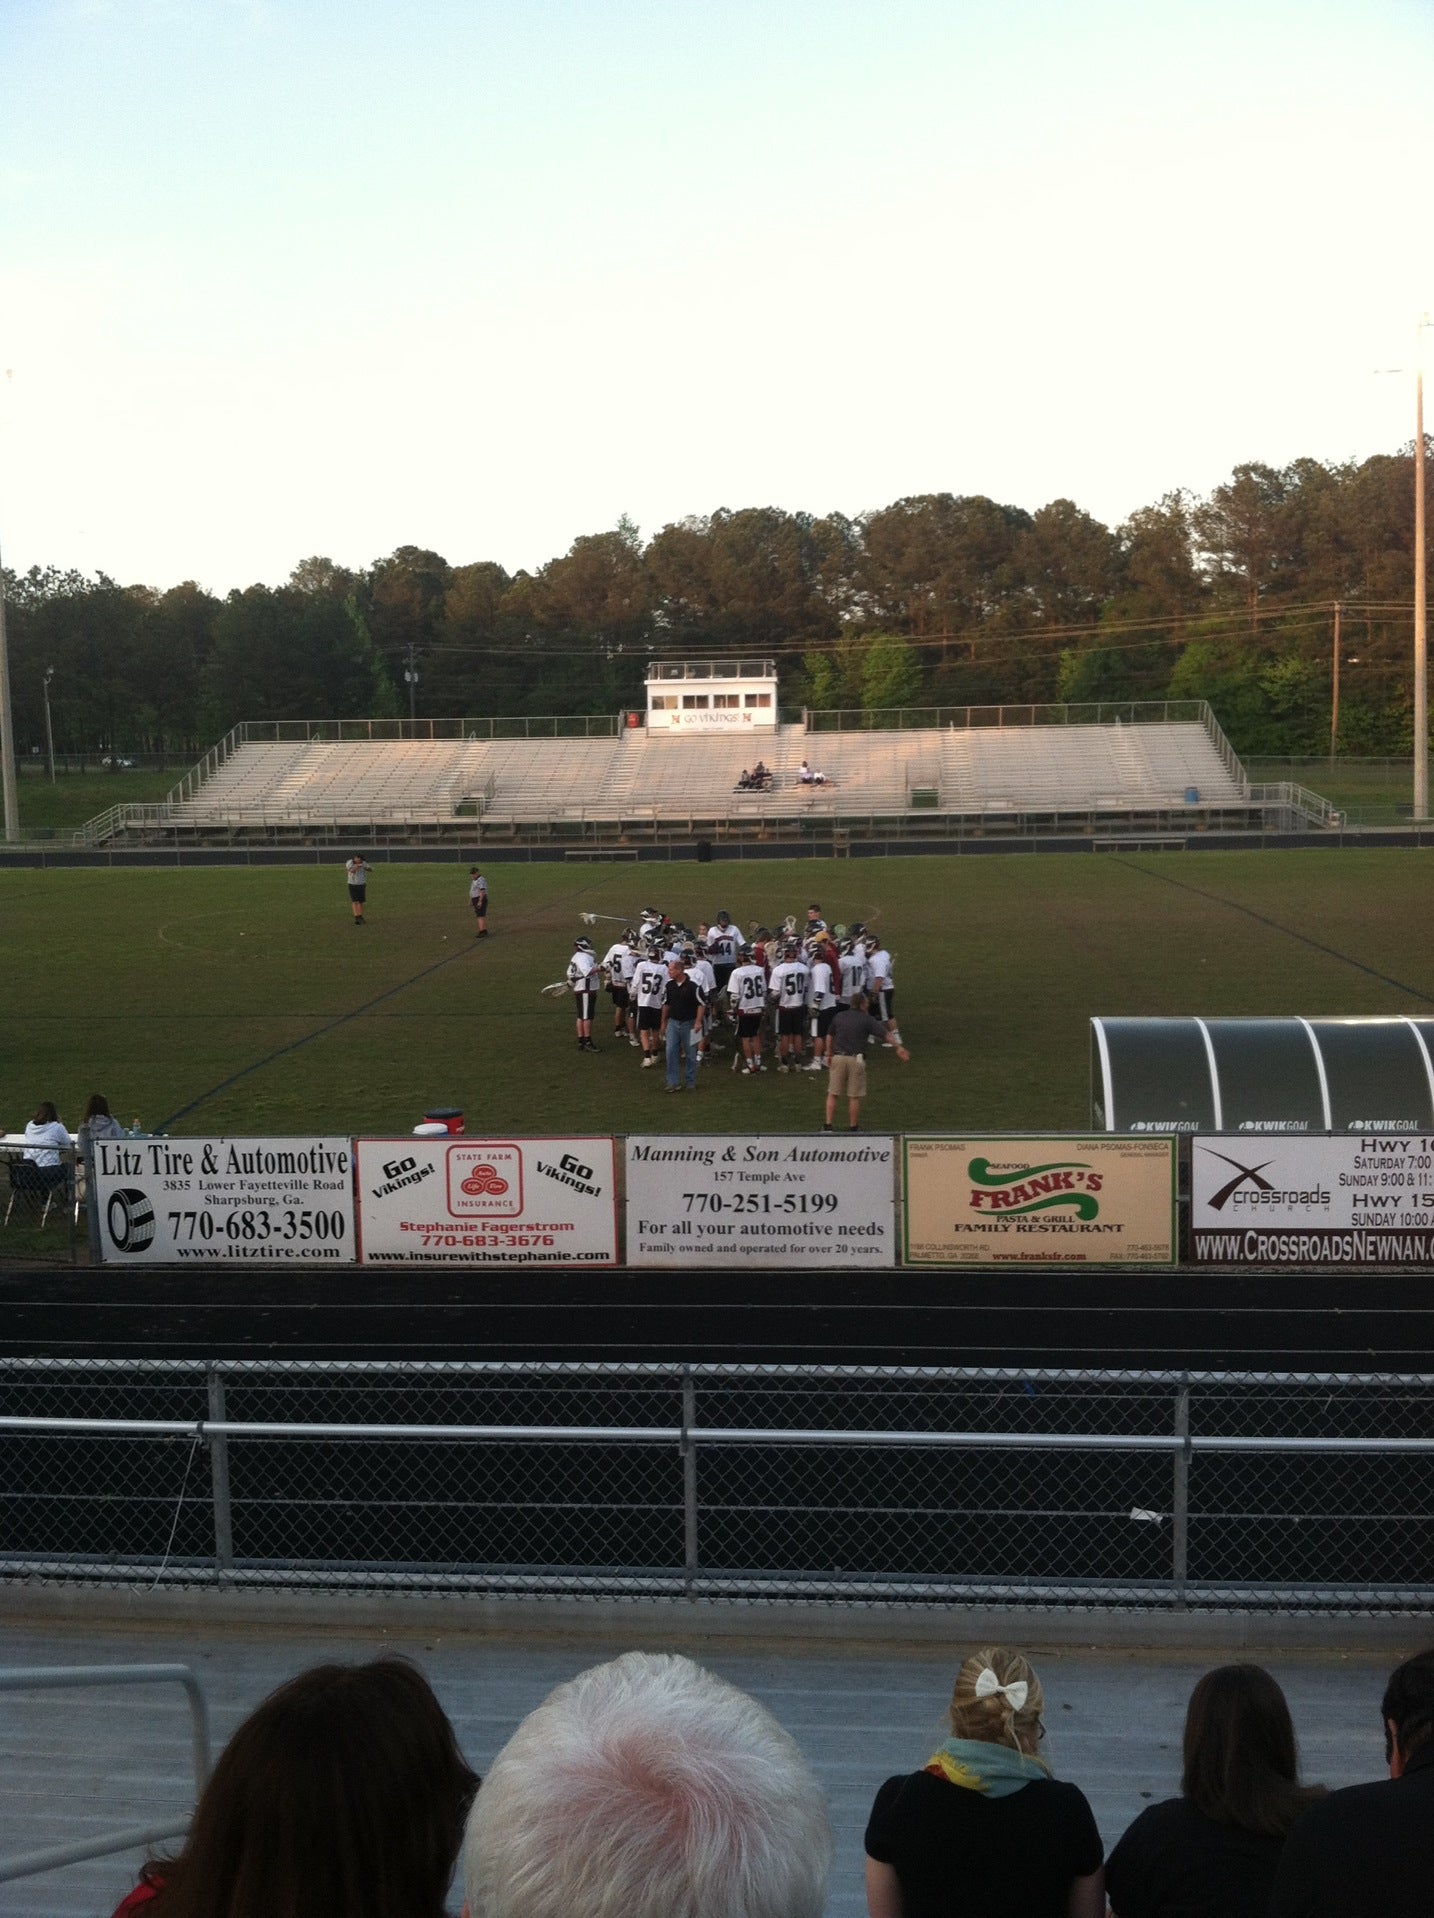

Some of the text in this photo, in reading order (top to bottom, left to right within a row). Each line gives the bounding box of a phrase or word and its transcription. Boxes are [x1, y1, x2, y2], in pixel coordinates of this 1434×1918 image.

[641, 972, 663, 995] 53
[743, 975, 763, 1000] 36
[785, 972, 804, 996] 50
[100, 1142, 348, 1176] Litz Tire & Automotive
[456, 1153, 512, 1161] STATE FARM
[631, 1145, 890, 1166] Manning & Son Automotive
[1407, 1156, 1431, 1169] 7:00
[382, 1156, 417, 1181] Go
[559, 1153, 594, 1181] Go
[371, 1162, 436, 1199] Vikings!
[535, 1160, 602, 1198] Vikings!
[714, 1171, 806, 1184] 157 Temple Ave
[1380, 1173, 1404, 1186] 9:00
[1406, 1173, 1416, 1186] &
[163, 1179, 345, 1193] 3835 Lower Fayetteville Road
[969, 1171, 1104, 1209] FRANK'S
[1233, 1183, 1331, 1204] crossroads
[204, 1194, 304, 1207] Sharpsburg, Ga.
[457, 1200, 513, 1208] INSURANCE
[682, 1193, 839, 1213] 770-251-5199
[168, 1210, 345, 1240] 770-683-3500
[996, 1215, 1076, 1223] PASTA & GRILL
[1351, 1213, 1397, 1226] SUNDAY
[1400, 1213, 1429, 1226] 10:00
[400, 1221, 575, 1235] Stephanie Fagerstrom
[638, 1220, 885, 1238] For all your automotive needs
[954, 1223, 1125, 1233] FAMILY RESTAURANT
[421, 1234, 554, 1247] 770-683-3676
[1195, 1230, 1434, 1261] WWW.CROSSROADSNEWNAN.
[176, 1245, 341, 1259] www.litztire.com
[368, 1250, 610, 1264] www.insurewithstephanie.com
[639, 1243, 677, 1255] Family
[679, 1243, 714, 1253] owned
[716, 1243, 737, 1253] and
[740, 1244, 787, 1255] operated
[790, 1243, 806, 1253] for
[808, 1245, 833, 1253] over
[835, 1244, 848, 1253] 20
